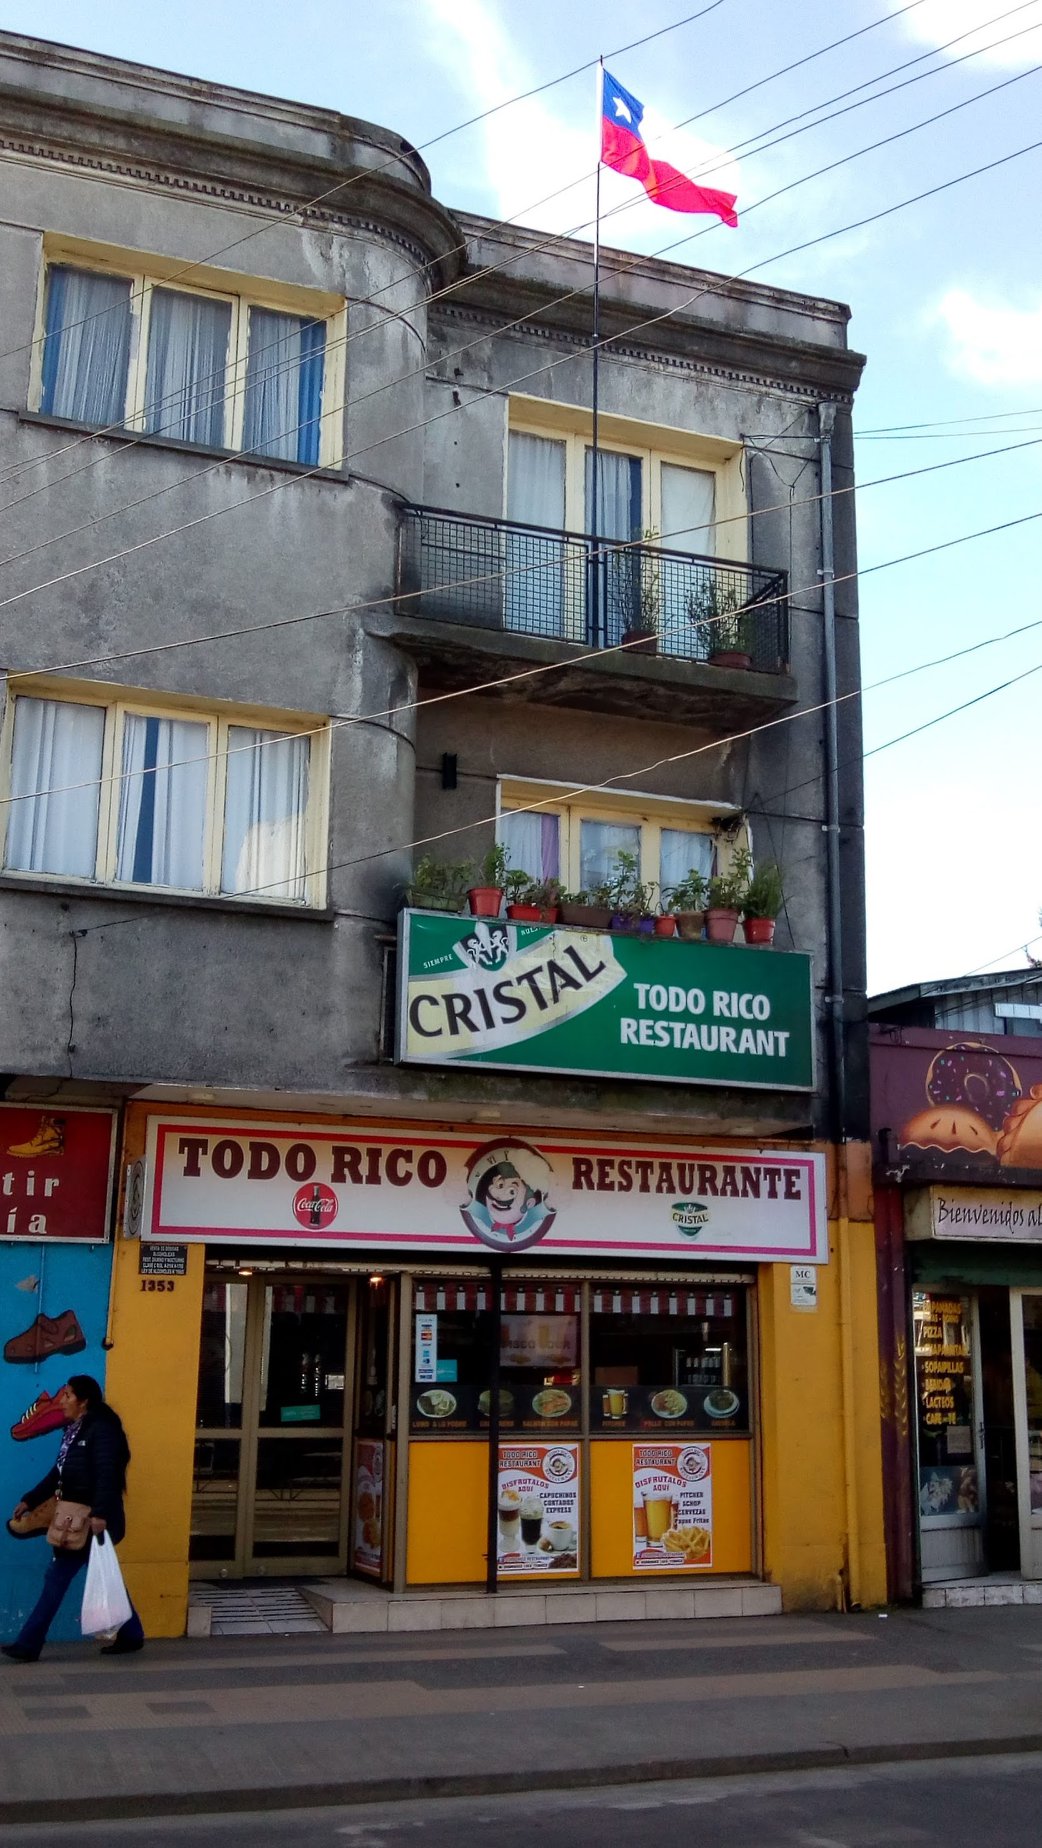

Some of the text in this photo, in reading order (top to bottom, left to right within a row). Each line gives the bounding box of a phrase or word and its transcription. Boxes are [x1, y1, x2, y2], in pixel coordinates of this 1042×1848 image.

[423, 953, 454, 969] SIEMPRE
[409, 945, 606, 1038] CRISTAL
[633, 983, 771, 1021] TODO RICO
[620, 1017, 790, 1058] RESTAURANT
[178, 1138, 448, 1188] TODO RICO
[572, 1156, 801, 1200] RESTAURANTE
[672, 1212, 709, 1225] CRISTAL
[938, 1197, 1024, 1234] Bienvenidos
[795, 1270, 811, 1279] MC
[139, 1279, 174, 1292] 1353
[923, 1326, 942, 1338] PIZZA
[925, 1361, 964, 1374] SOPAIPILLAS
[926, 1396, 954, 1409] LACTEOS
[501, 1478, 549, 1490] DISFRUTALOS
[635, 1475, 687, 1488] DISFRUTALOS
